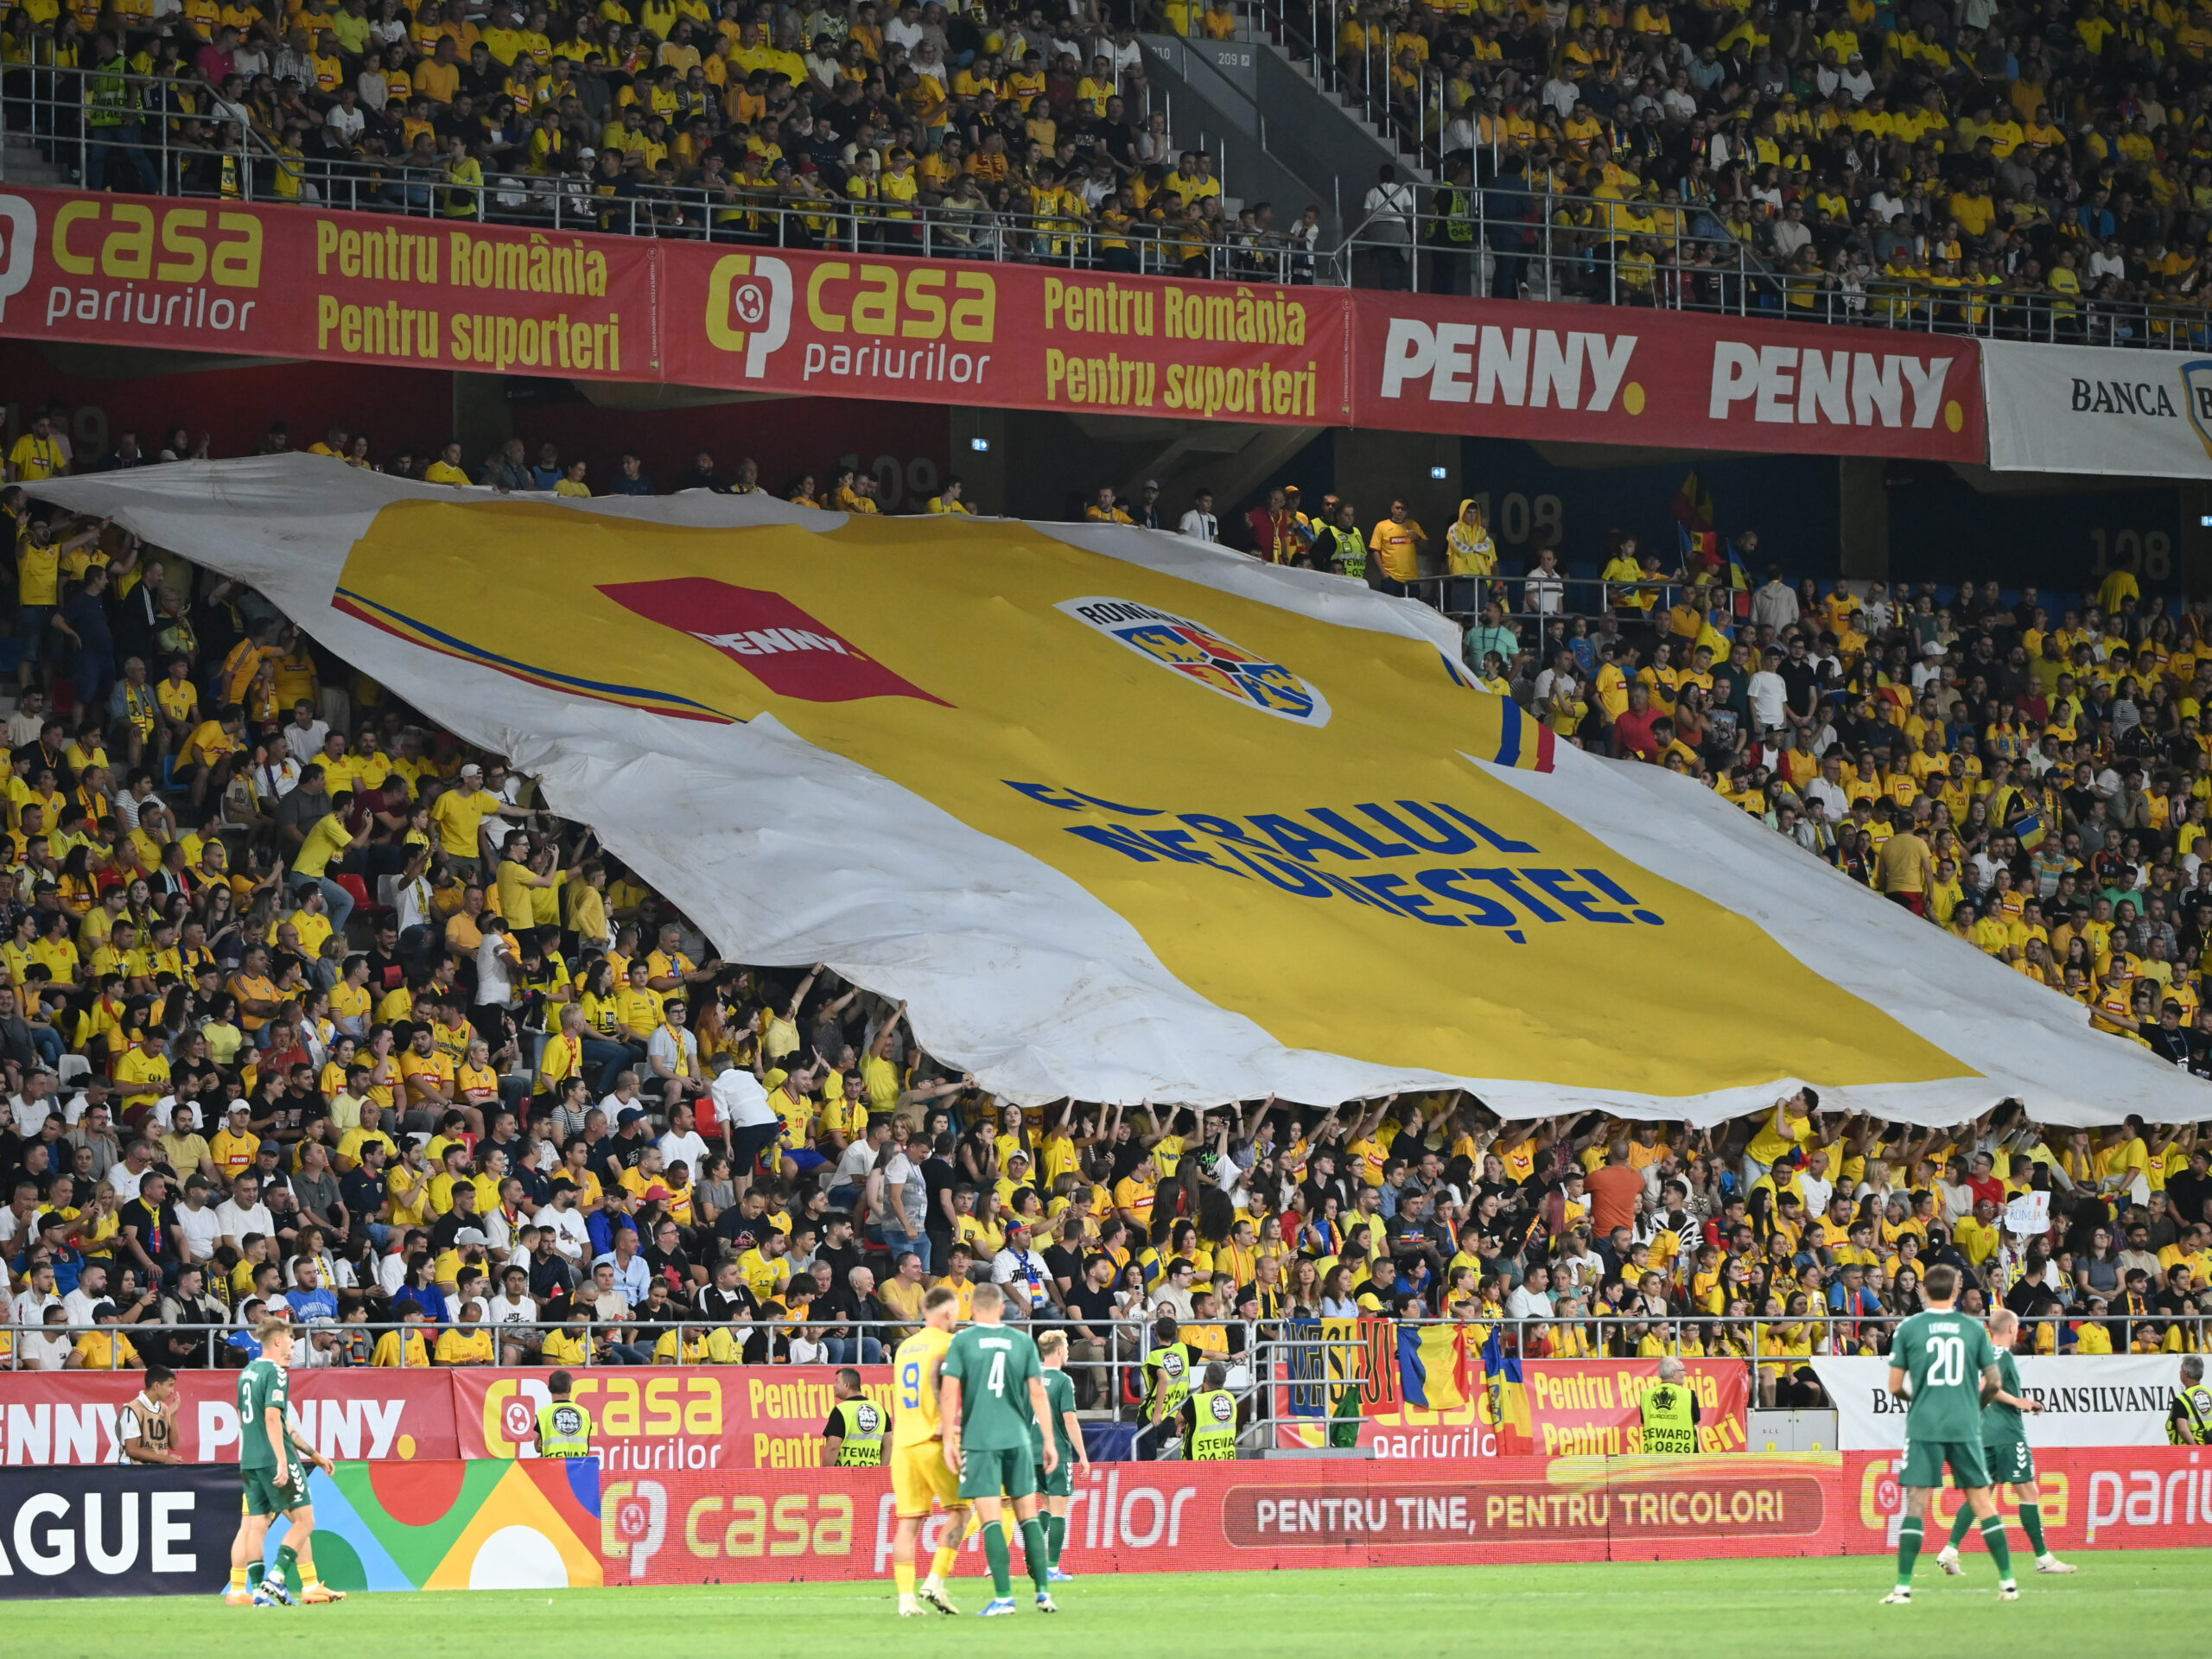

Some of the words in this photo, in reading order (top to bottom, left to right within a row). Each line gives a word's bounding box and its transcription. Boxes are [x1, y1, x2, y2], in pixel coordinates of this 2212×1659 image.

[1218, 52, 1237, 66] 209
[53, 200, 263, 288] casa
[318, 220, 438, 283] Pentru
[450, 232, 607, 296] România
[47, 283, 255, 331] pariurilor
[807, 262, 996, 343] casa
[1045, 276, 1154, 336] Pentru
[1165, 286, 1306, 346] România
[318, 295, 439, 359] Pentru
[450, 313, 620, 372] suporteri
[804, 340, 990, 384] pariurilor
[1046, 348, 1156, 406] Pentru
[1164, 360, 1317, 417] suporteri
[2071, 378, 2178, 417] BANCA
[2090, 529, 2171, 581] 108
[795, 1117, 804, 1128] 10
[988, 1351, 1006, 1398] 4
[1926, 1336, 1965, 1386] 20
[242, 1382, 254, 1424] 3
[570, 1377, 722, 1435] casa
[749, 1378, 836, 1419] Pentru
[902, 1362, 920, 1408] 9
[1212, 1398, 1230, 1411] SAS
[1534, 1372, 1615, 1410] Pentru
[1618, 1368, 1719, 1410] Roia
[0, 1403, 123, 1465] NNY
[147, 1417, 166, 1440] 10
[556, 1411, 578, 1424] SAS
[858, 1409, 875, 1421] SAS
[1643, 1427, 1691, 1440] STEWARD
[591, 1438, 721, 1470] ariurilor
[754, 1433, 830, 1468] Pentr
[1373, 1427, 1497, 1458] pariurilo
[1541, 1421, 1620, 1455] Pentru
[0, 1491, 196, 1576] GUE
[686, 1494, 853, 1556] casa
[1257, 1497, 1386, 1533] PENTRU
[1395, 1495, 1476, 1535] TINE,
[1487, 1495, 1608, 1528] PENTRU
[1618, 1491, 1783, 1525] TRICOLORI
